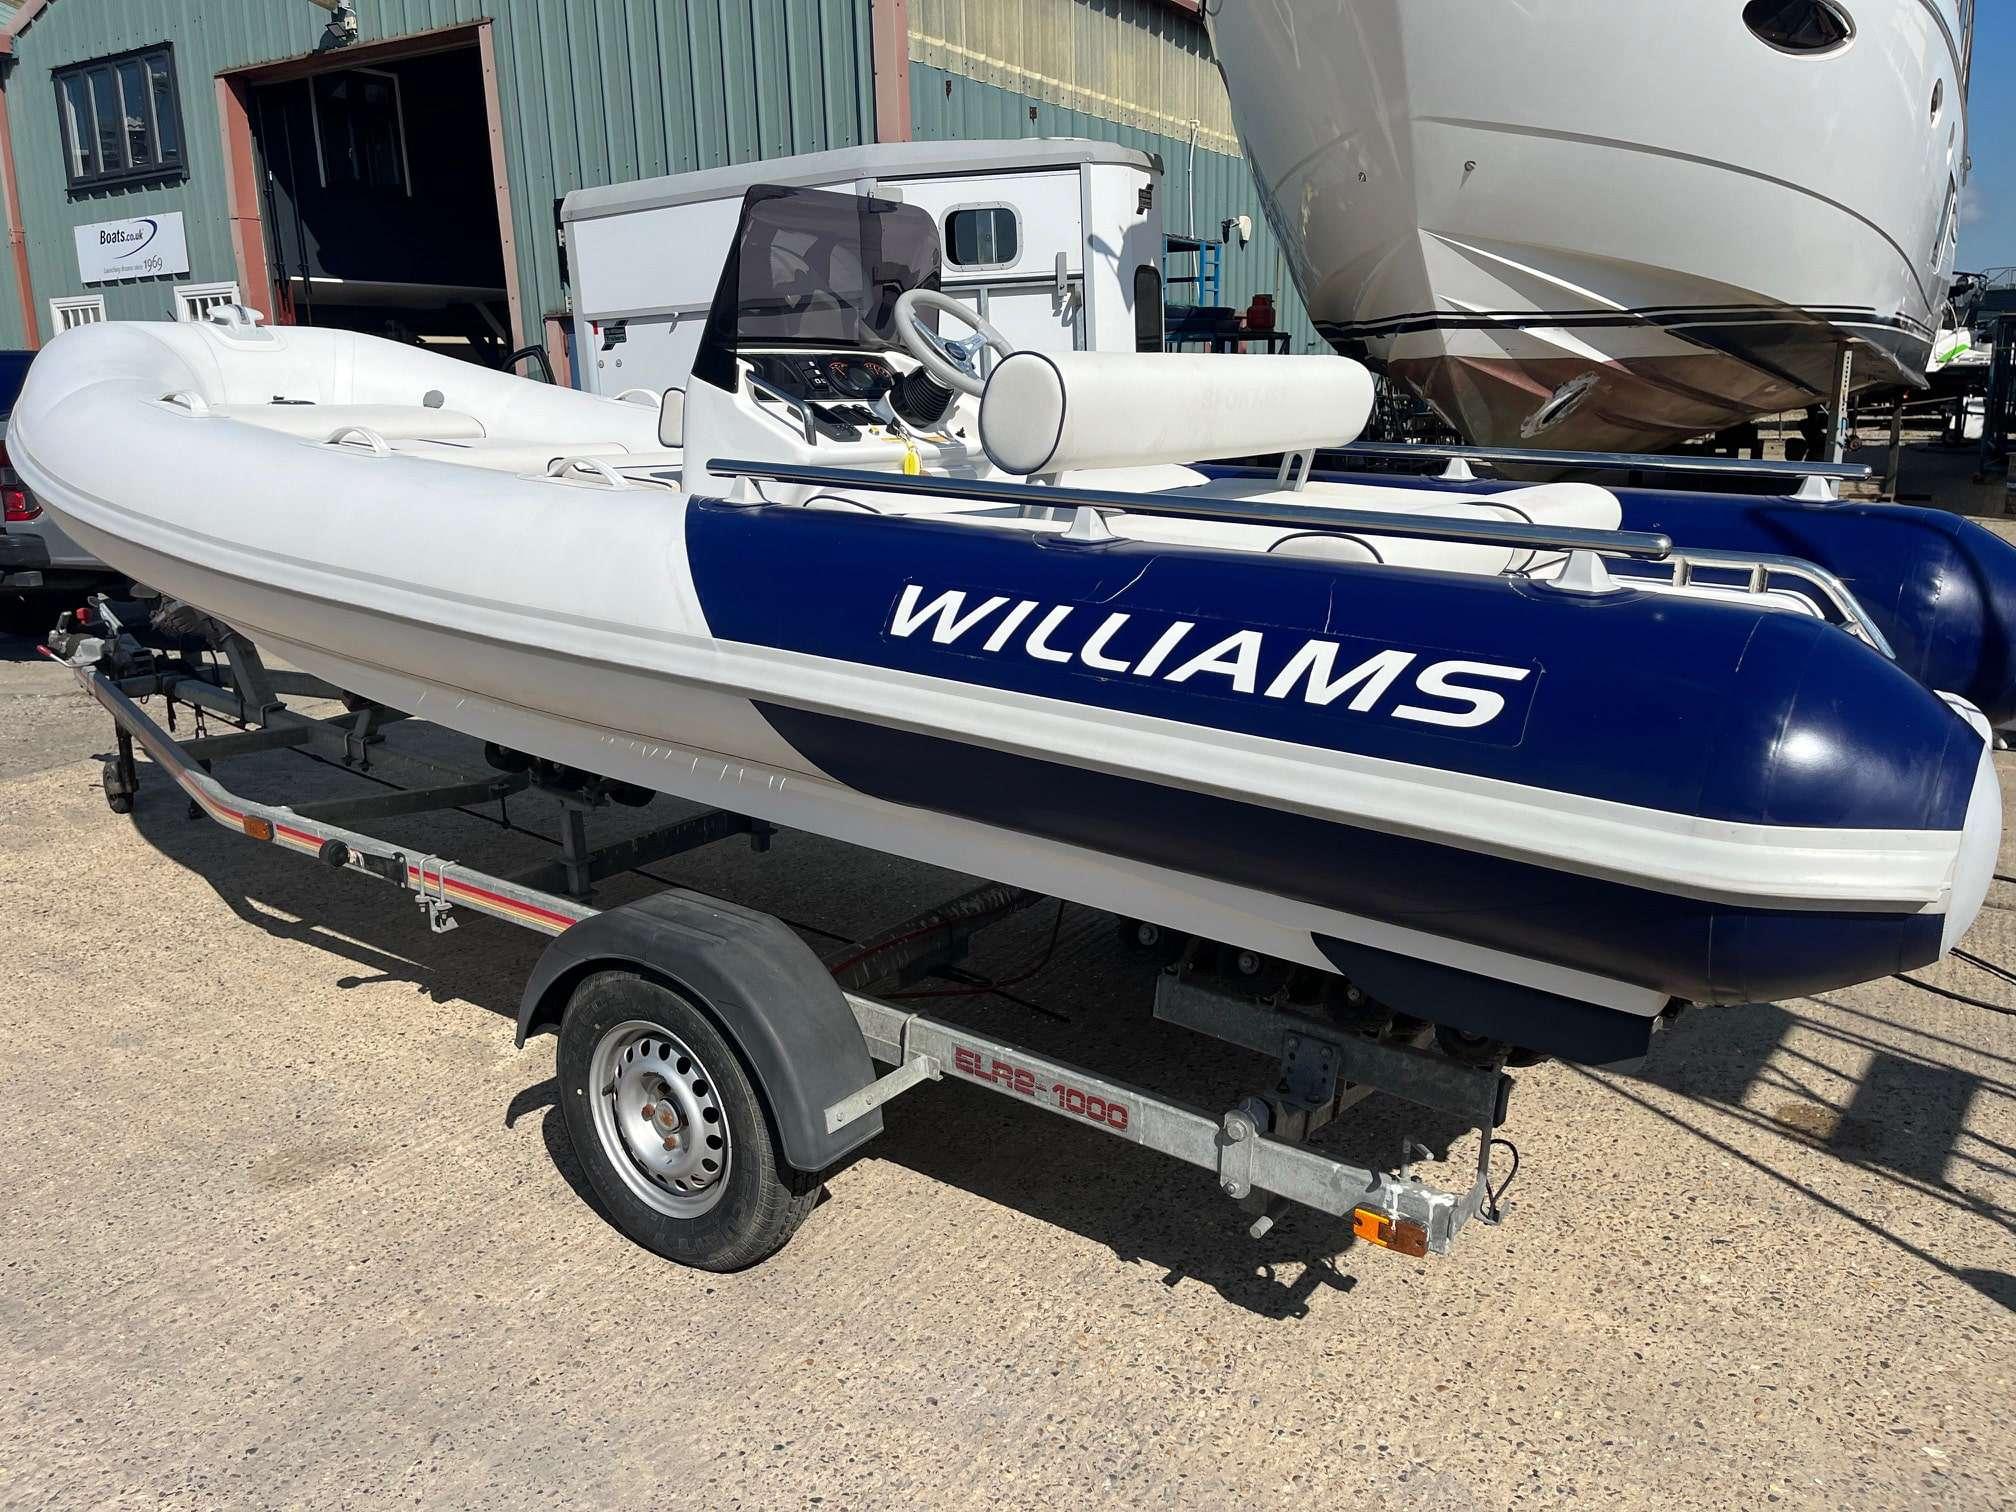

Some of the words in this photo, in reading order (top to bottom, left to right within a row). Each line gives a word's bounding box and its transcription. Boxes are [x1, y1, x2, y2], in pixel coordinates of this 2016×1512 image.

[144, 255, 163, 272] 1969
[889, 584, 1530, 728] WILLIAMS
[955, 1046, 1128, 1132] ELR2-1000
